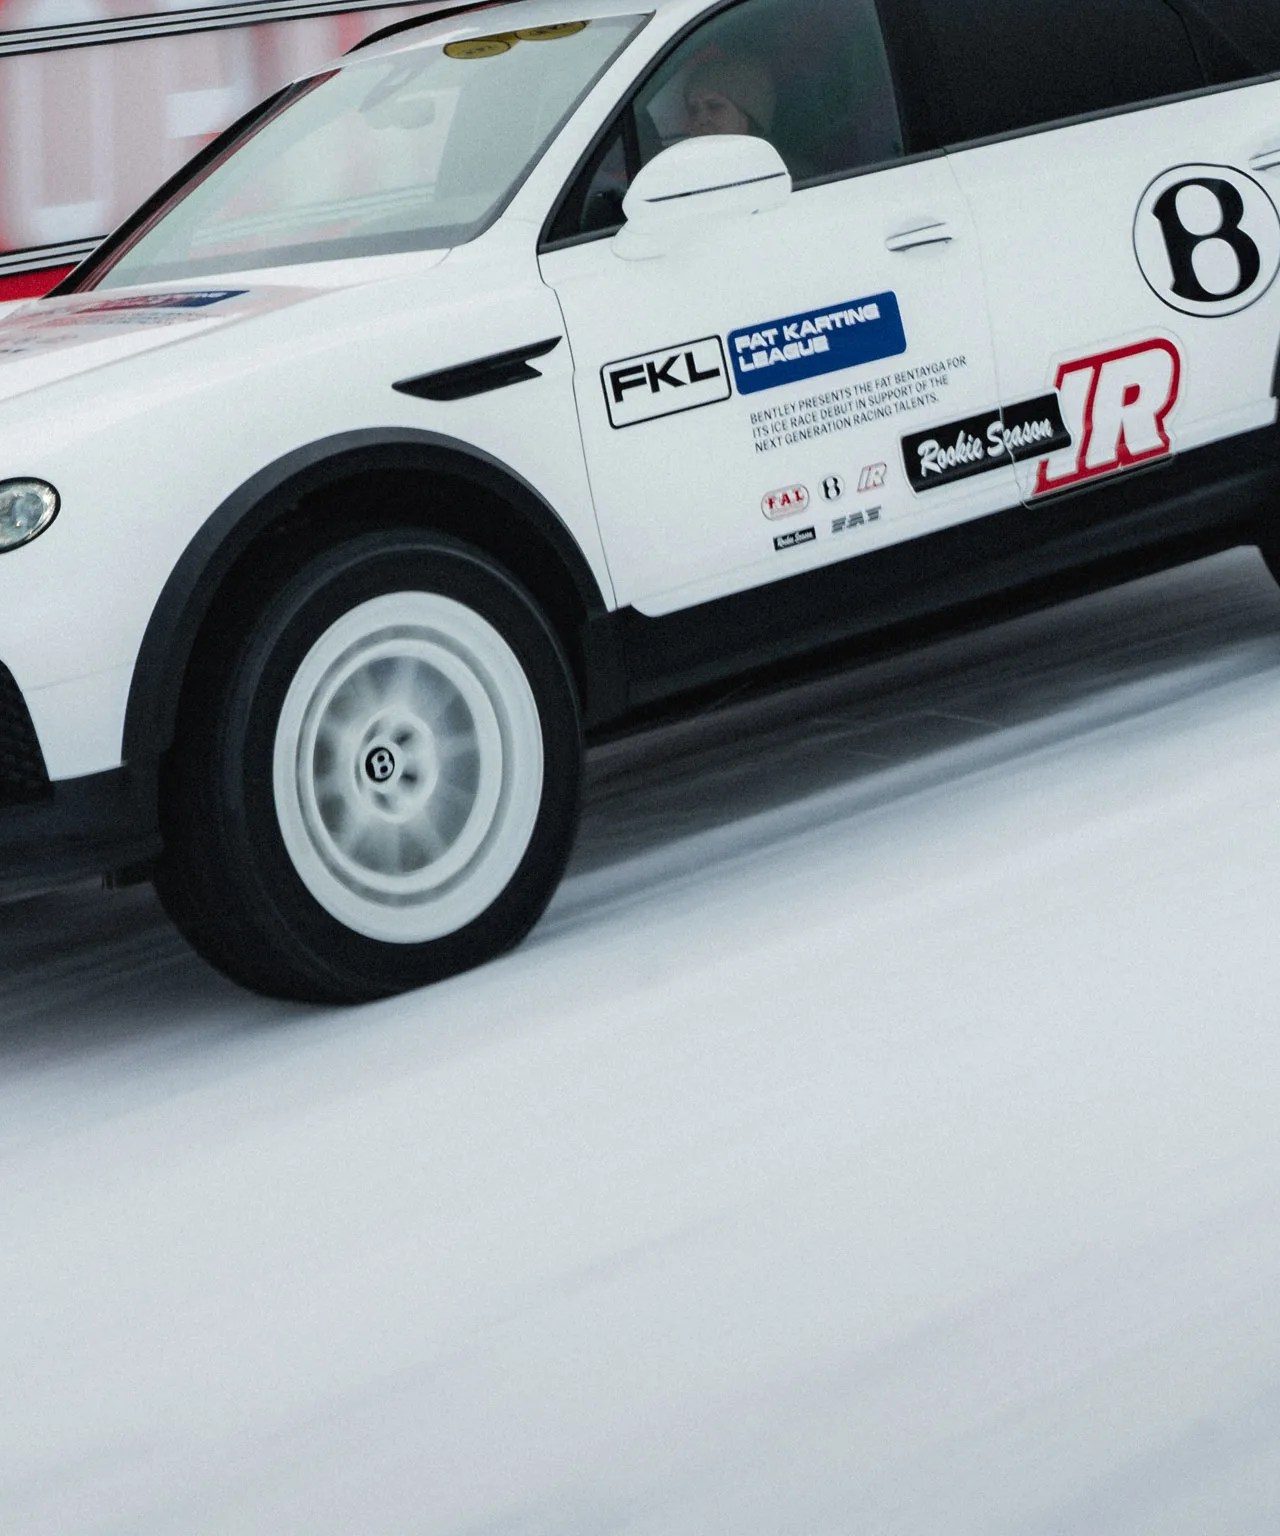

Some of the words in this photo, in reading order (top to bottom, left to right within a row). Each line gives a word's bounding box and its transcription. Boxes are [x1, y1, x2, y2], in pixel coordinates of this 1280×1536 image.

[1151, 177, 1261, 302] B
[734, 328, 779, 354] FAT
[783, 303, 881, 340] KARTING
[739, 335, 830, 373] LEAGUE
[609, 352, 721, 403] FKL
[750, 402, 797, 425] BENTLEY
[798, 387, 852, 413] PRESENTS
[854, 380, 873, 396] THE
[874, 375, 891, 390] FAT
[894, 360, 946, 384] BENTAYGA
[947, 355, 967, 371] FOR
[752, 423, 769, 439] ITS
[770, 418, 789, 434] ICE
[791, 411, 817, 429] RACE
[820, 402, 854, 421] DEBUT
[855, 398, 867, 413] IN
[869, 385, 913, 407] SUPPORT
[914, 379, 928, 394] OF
[929, 374, 949, 388] THE
[754, 435, 782, 453] NEXT
[785, 416, 852, 445] GENERATION
[853, 404, 893, 424] RACING
[894, 390, 939, 413] TALENTS.
[917, 430, 984, 477] Rookie
[986, 418, 1053, 458] Season
